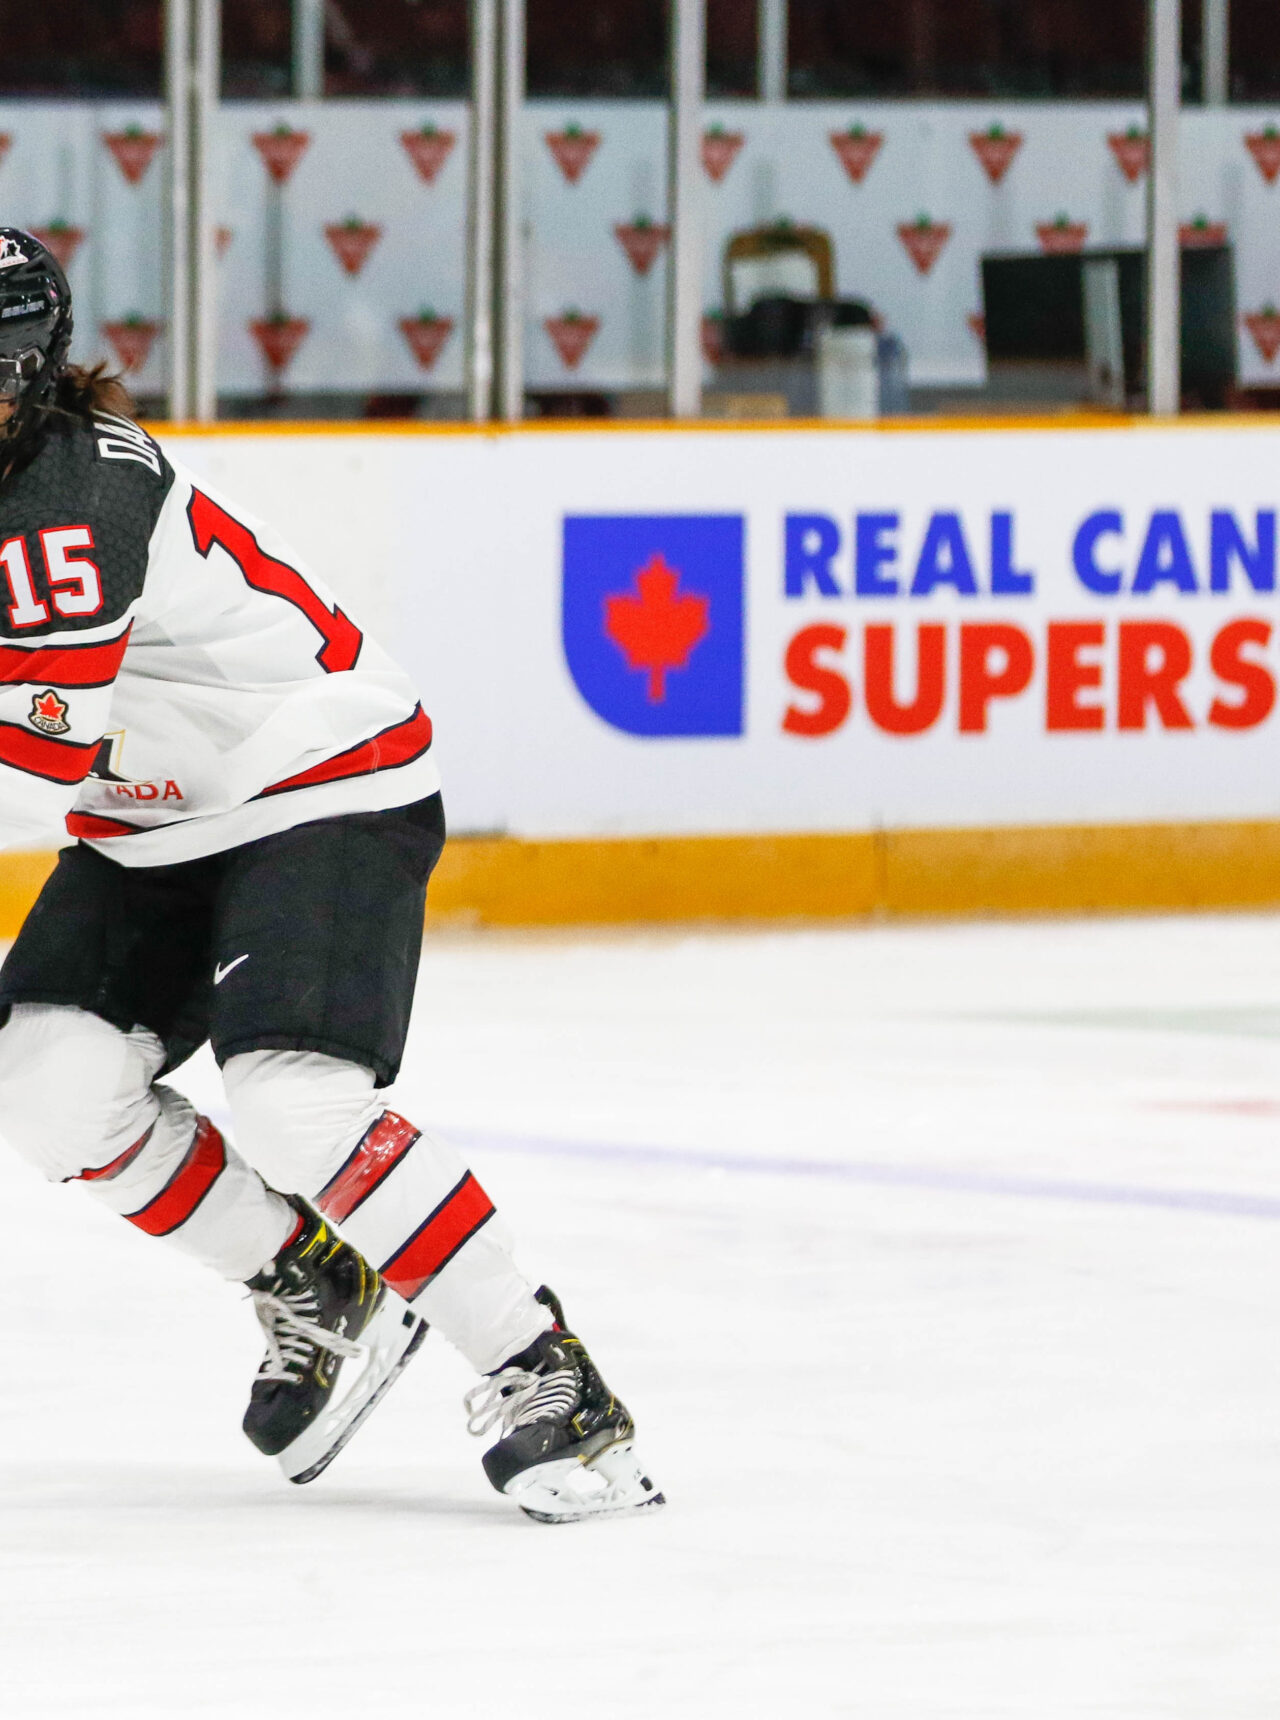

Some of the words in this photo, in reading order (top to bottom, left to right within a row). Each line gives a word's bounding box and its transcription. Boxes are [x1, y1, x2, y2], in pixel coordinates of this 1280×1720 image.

[783, 511, 1034, 598] REAL
[1070, 508, 1278, 595] CAN
[781, 617, 1278, 737] SUPERS
